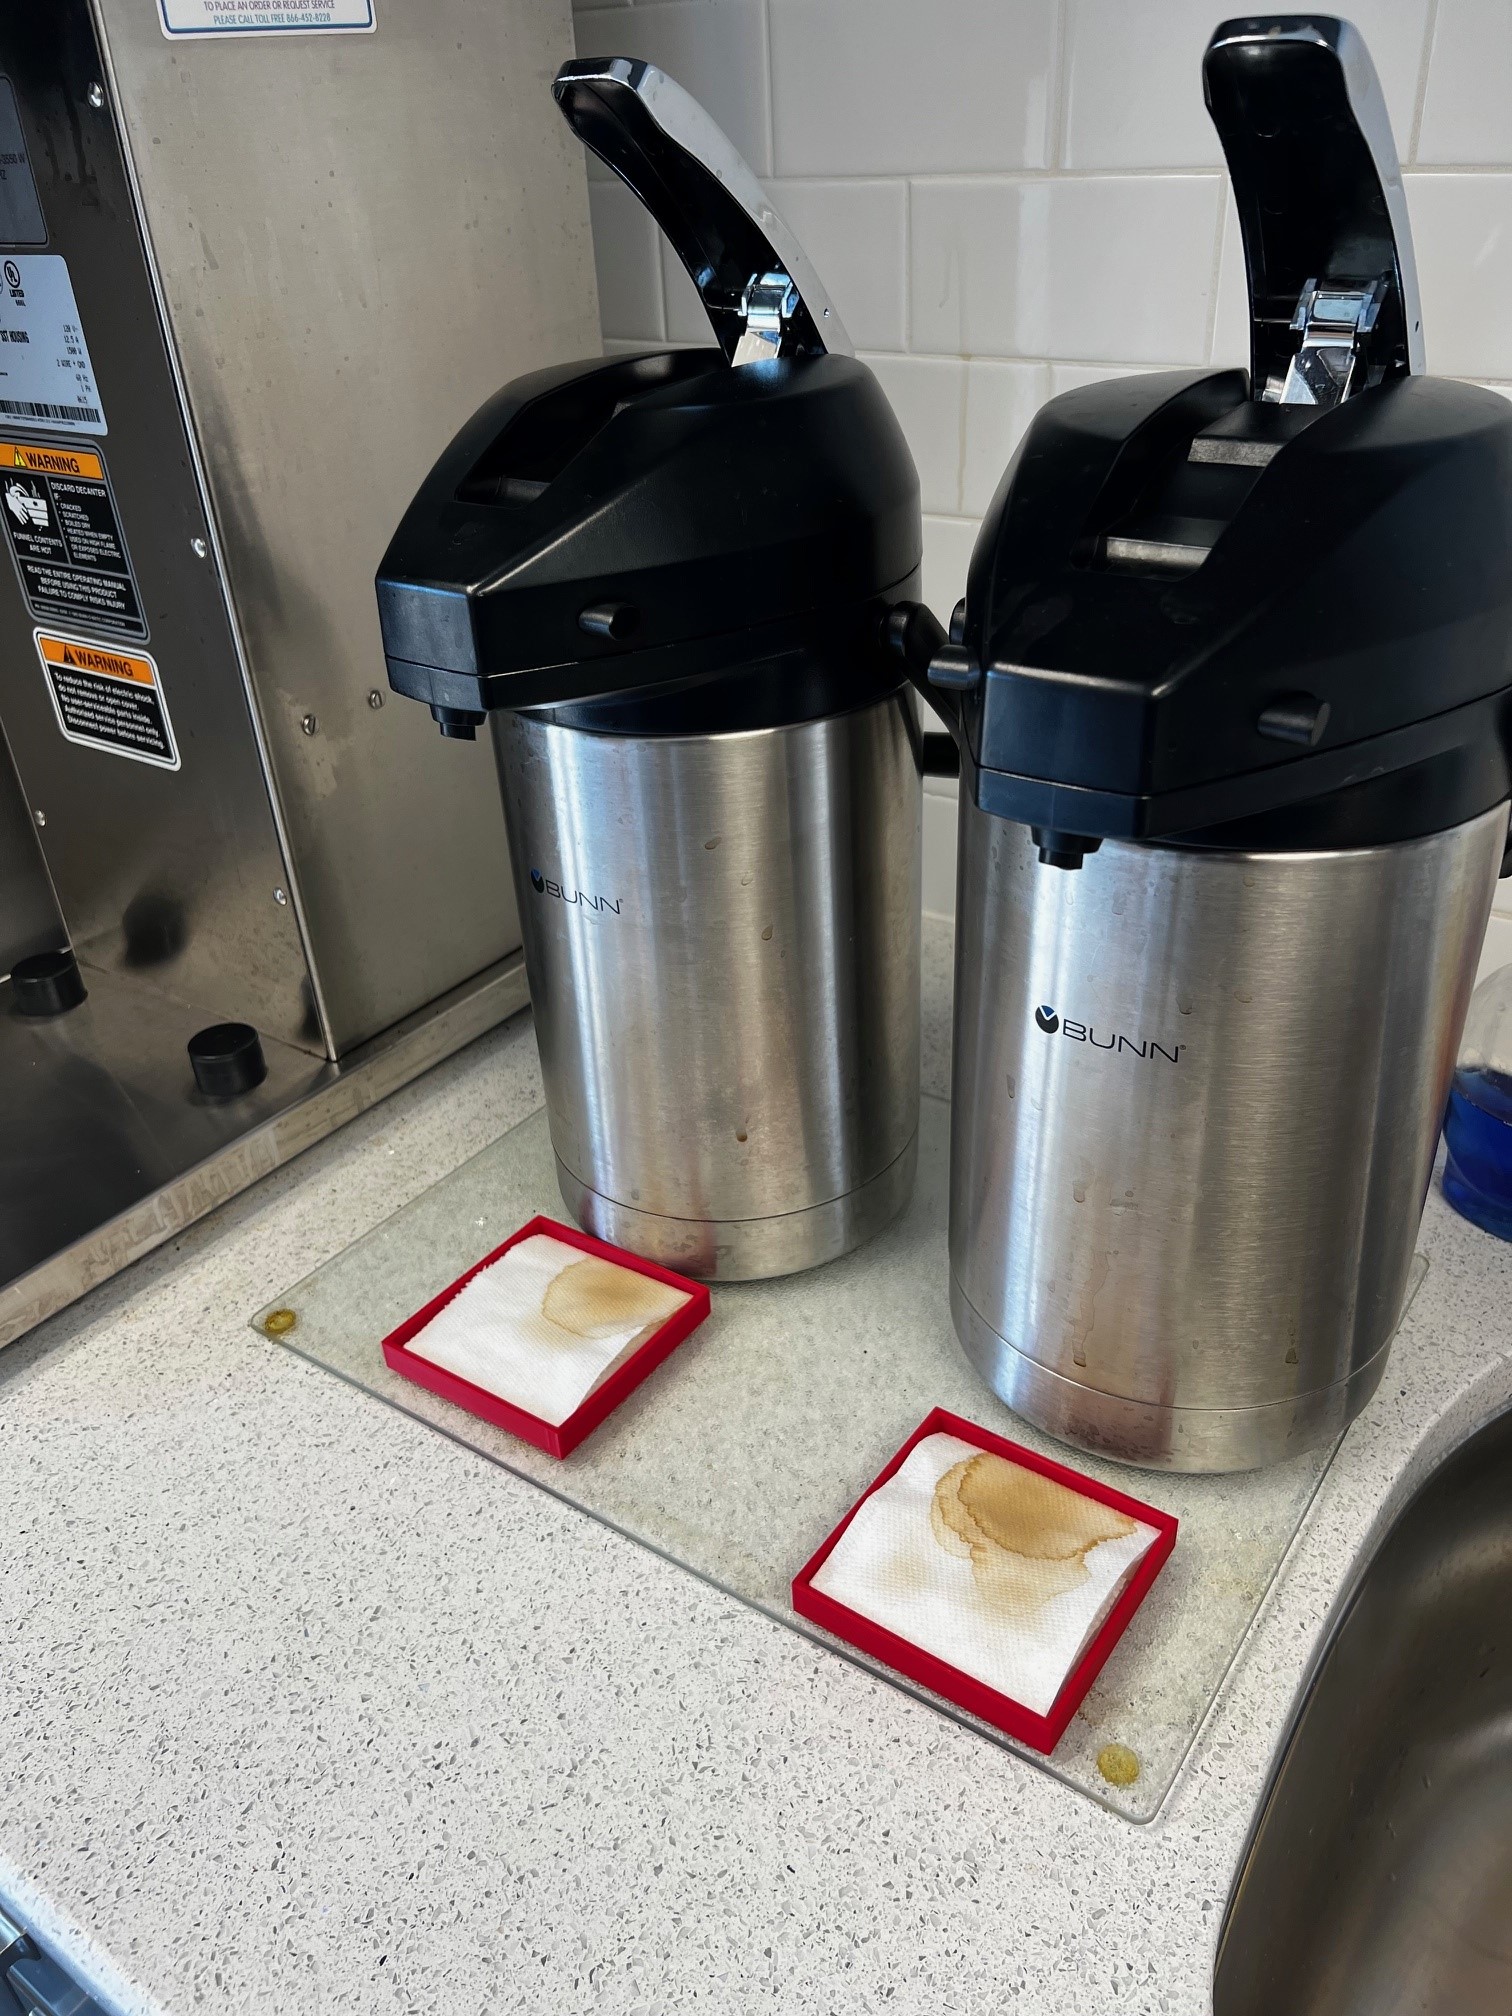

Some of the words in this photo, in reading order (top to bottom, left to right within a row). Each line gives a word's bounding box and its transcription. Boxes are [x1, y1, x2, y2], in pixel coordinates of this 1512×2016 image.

[204, 1, 214, 11] TO
[214, 1, 236, 11] PLACE
[237, 1, 248, 10] AN
[248, 0, 271, 10] ORDER
[272, 0, 282, 10] OR
[282, 0, 310, 10] REQUEST
[311, 0, 335, 9] SERVICE
[213, 15, 237, 25] PLEASE
[238, 14, 255, 24] CALL
[255, 14, 270, 24] TOLL
[270, 14, 286, 23] FREE
[286, 12, 331, 23] 866-452-8228
[26, 452, 80, 473] WARNING
[50, 482, 75, 493] DISCARD
[75, 485, 106, 497] DECANTER
[60, 502, 82, 512] CRACKED
[62, 511, 89, 521] SCRATCHED
[65, 519, 81, 528] BOILED
[66, 528, 84, 536] HEATED
[84, 530, 98, 538] WHEN
[98, 532, 113, 540] EMPTY
[13, 532, 35, 543] FUNNEL
[34, 535, 63, 547] CONTENTS
[29, 544, 41, 553] ARE
[40, 546, 52, 555] HOT
[27, 565, 42, 574] READ
[42, 567, 53, 577] THE
[53, 570, 72, 580] ENTIRE
[72, 573, 103, 587] OPERATING
[102, 579, 126, 591] MANUAL
[40, 577, 62, 588] BEFORE
[62, 581, 79, 591] USING
[79, 584, 91, 594] THIS
[91, 586, 117, 599] PRODUCT
[37, 585, 60, 597] FAILURE
[60, 589, 68, 598] TO
[67, 591, 89, 602] COMPLY
[89, 596, 106, 606] RISKS
[106, 599, 125, 610] INJURY
[75, 649, 133, 677] WARNING
[54, 672, 63, 681] To
[63, 676, 83, 686] reduce
[82, 679, 93, 689] the
[93, 682, 105, 691] risk
[105, 685, 112, 693] of
[112, 687, 134, 699] electric
[134, 692, 155, 705] shock,
[58, 683, 66, 693] do
[66, 686, 77, 695] not
[76, 689, 98, 700] remove
[98, 694, 105, 702] or
[105, 696, 121, 705] open
[121, 700, 140, 711] cover.
[61, 693, 70, 703] No
[70, 698, 116, 715] user-serviceable
[116, 709, 132, 719] parts
[132, 711, 153, 725] inside.
[64, 704, 95, 719] Authorized
[95, 713, 116, 725] service
[116, 719, 146, 733] personnel
[145, 726, 160, 738] only.
[67, 714, 99, 730] Disconnect
[99, 724, 117, 735] power
[116, 727, 136, 740] before
[136, 734, 165, 750] servicing.
